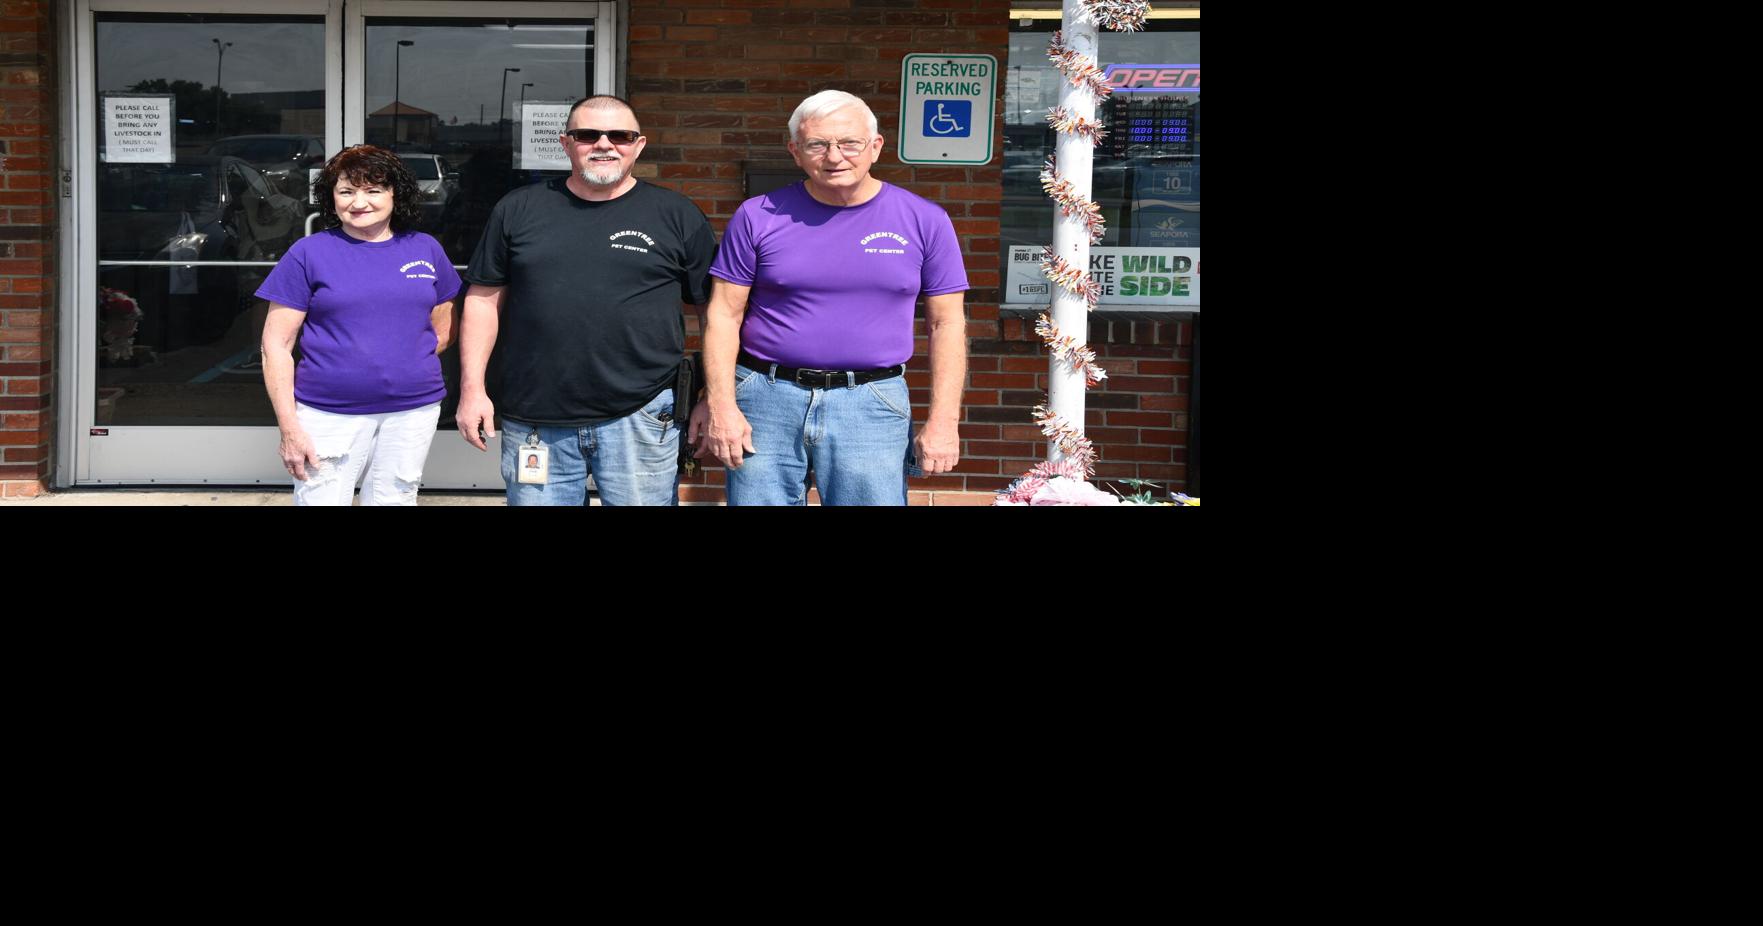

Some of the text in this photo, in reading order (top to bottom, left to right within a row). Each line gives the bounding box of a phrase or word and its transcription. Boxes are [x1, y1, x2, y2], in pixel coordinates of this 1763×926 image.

[911, 63, 988, 77] RESERVED
[915, 81, 981, 96] PARKING
[1163, 176, 1182, 190] 10
[610, 230, 655, 246] GREENTREE
[860, 231, 909, 246] GREENTREE
[624, 245, 648, 253] CENTER
[1014, 252, 1030, 261] BUG
[1121, 255, 1192, 274] WILD
[1119, 275, 1192, 296] SIDE
